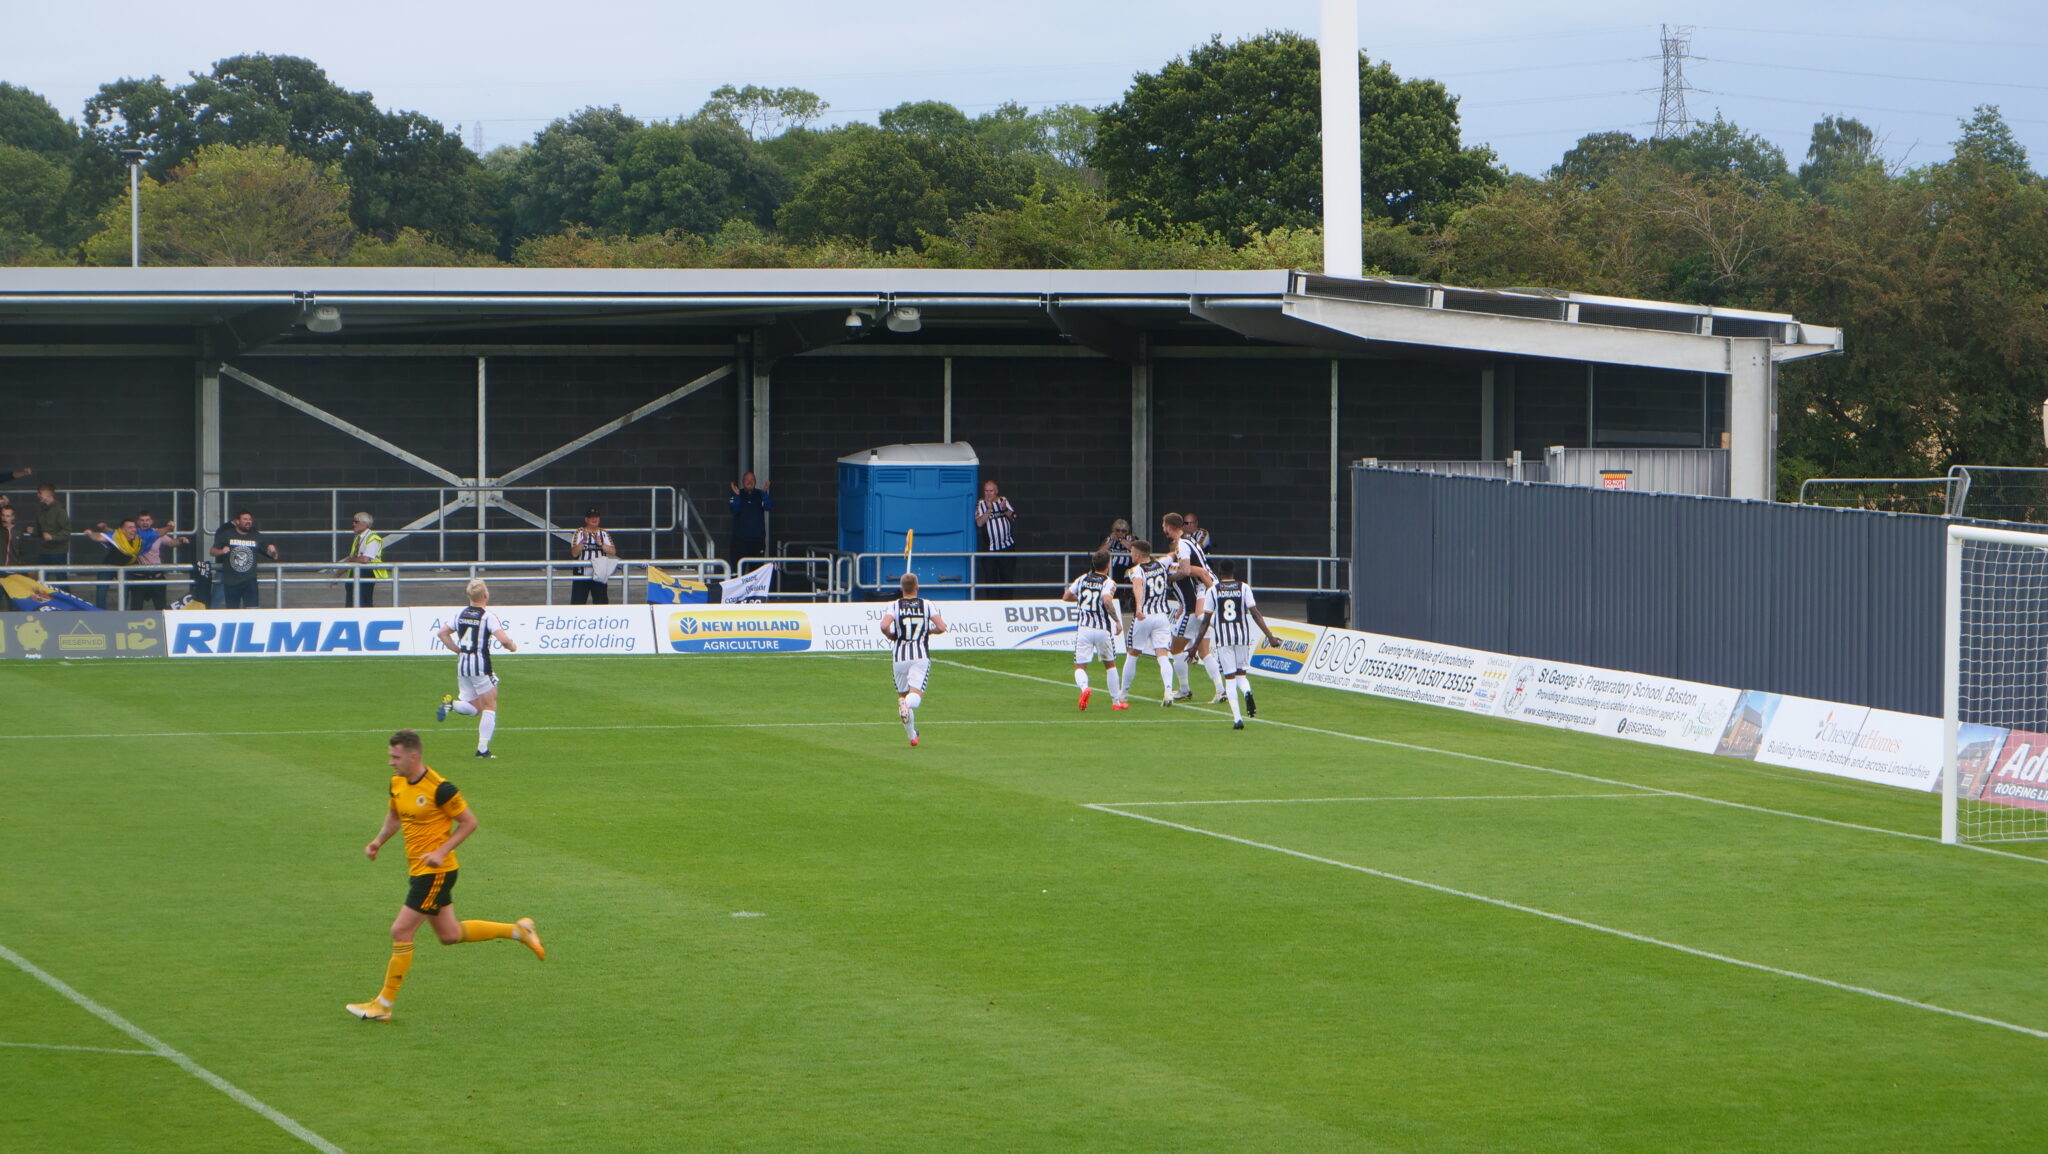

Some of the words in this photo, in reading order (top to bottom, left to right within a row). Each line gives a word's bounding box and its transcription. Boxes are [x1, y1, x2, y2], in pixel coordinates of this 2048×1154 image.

[1146, 574, 1165, 597] 10
[1217, 590, 1241, 598] ADRIANO
[1080, 589, 1100, 611] 21
[899, 607, 924, 616] HALL
[1005, 607, 1079, 623] BURDE
[1223, 599, 1237, 621] 8
[535, 615, 630, 631] Fabrication
[701, 620, 733, 632] NEW
[736, 620, 800, 632] HOLLAND
[823, 624, 869, 636] LOUTH
[902, 616, 924, 640] 17
[1007, 625, 1040, 633] GROUP
[173, 619, 404, 654] RILMAC
[460, 627, 473, 651] 4
[538, 634, 636, 651] Scaffolding
[825, 638, 872, 650] NORTH
[876, 638, 893, 650] KY
[955, 636, 996, 648] BRIGG
[1041, 639, 1070, 648] Experts
[703, 640, 780, 651] AGRICULTURE
[1282, 639, 1309, 654] HOLLAND
[1378, 641, 1404, 657] Covering
[1403, 645, 1414, 658] the
[1413, 647, 1432, 662] Whole
[1431, 650, 1440, 666] of
[1438, 650, 1476, 669] Lincolnshire
[1259, 657, 1292, 672] AGRICULTURE
[1359, 658, 1388, 677] 07555
[1442, 672, 1478, 694] 235155
[1538, 667, 1549, 682] St
[1548, 669, 1586, 691] George's
[1585, 675, 1633, 699] Preparatory
[1665, 687, 1698, 706] Boston.
[1535, 688, 1561, 705] Providing
[1560, 694, 1568, 702] an
[1567, 694, 1601, 711] outstanding
[1600, 699, 1629, 713] education
[1628, 703, 1637, 713] for
[1636, 705, 1659, 717] children
[1659, 708, 1676, 721] aged
[1624, 721, 1667, 738] @SGPSBoston
[1767, 740, 1797, 760] Building
[1795, 744, 1819, 761] homes
[1818, 749, 1826, 761] in
[1826, 750, 1851, 767] Boston
[1850, 756, 1866, 769] and
[1865, 760, 1889, 774] across
[1888, 761, 1932, 780] Lincolnshire
[1994, 783, 2038, 801] ROOFING
